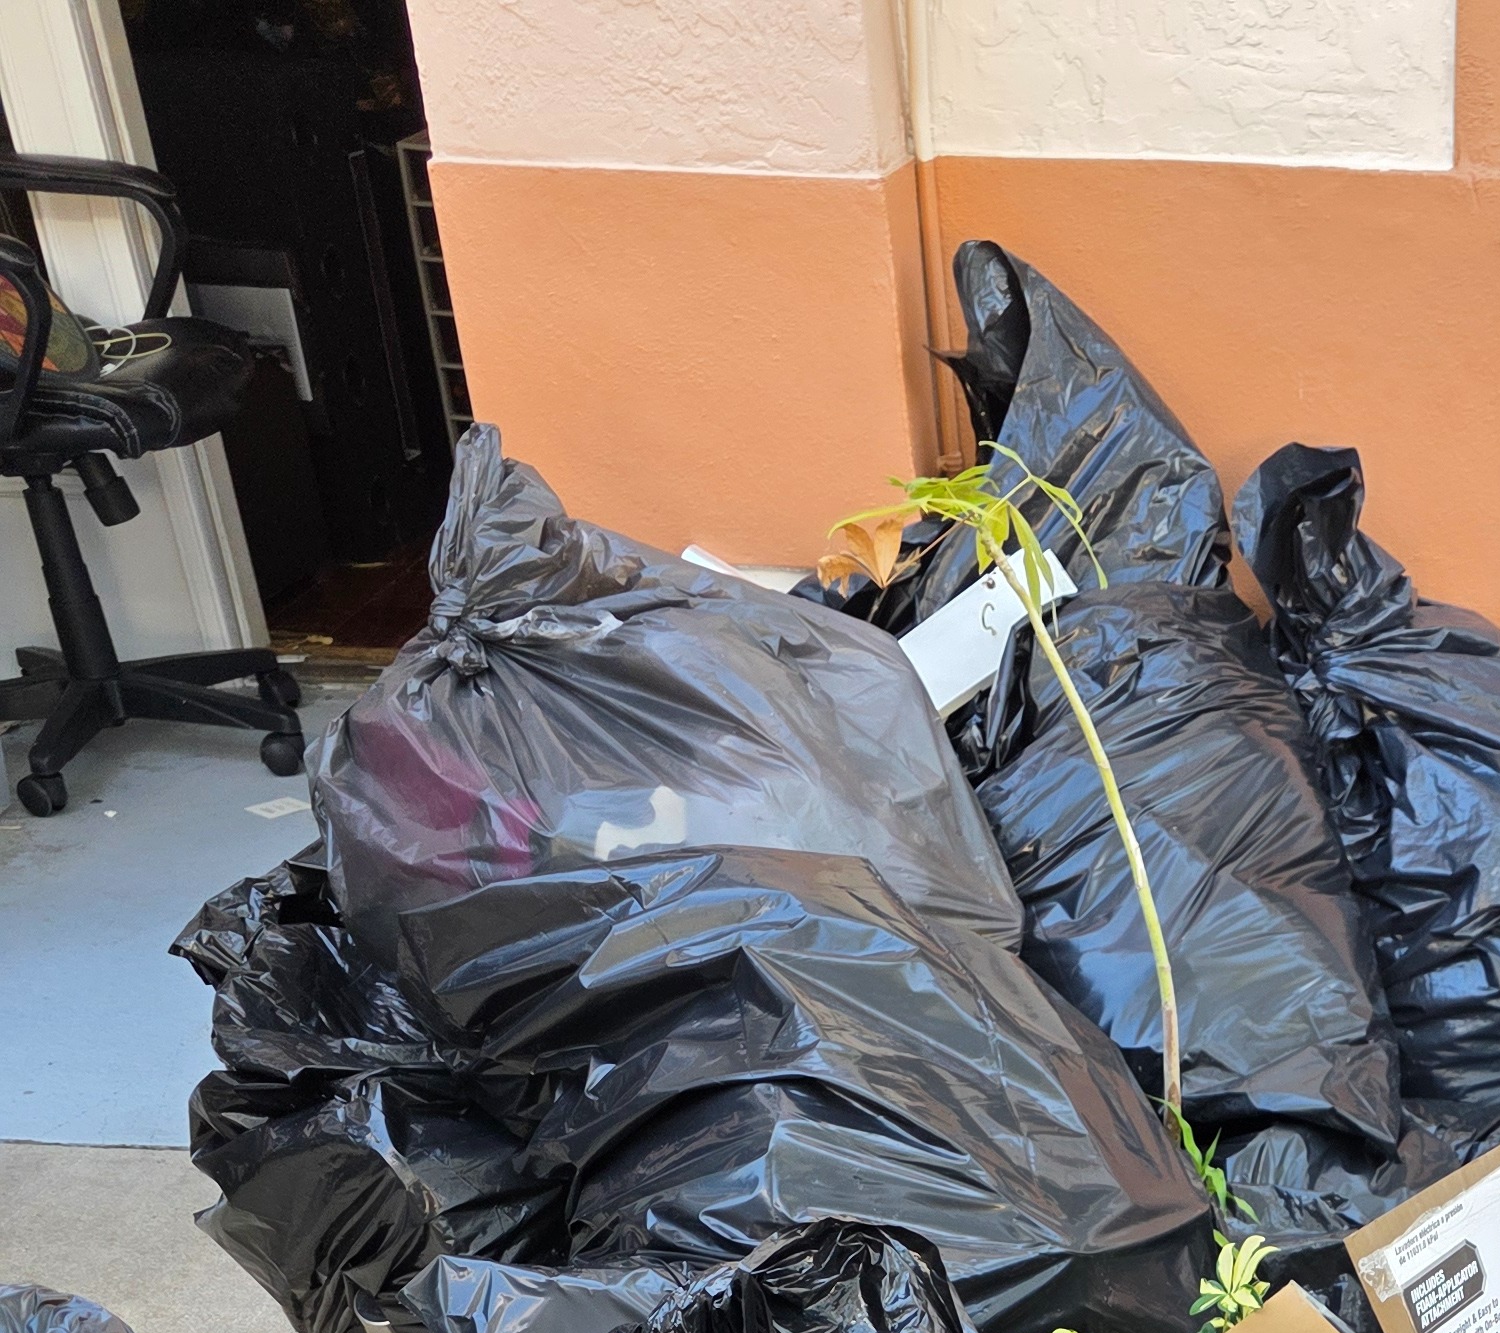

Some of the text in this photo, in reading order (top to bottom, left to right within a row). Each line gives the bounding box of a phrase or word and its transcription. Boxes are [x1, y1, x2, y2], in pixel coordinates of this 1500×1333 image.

[1411, 1269, 1446, 1304] INCLUDES
[1415, 1261, 1479, 1317] FOAM-APPLICATOR
[1420, 1286, 1465, 1329] ATTACHMENT
[1478, 1306, 1491, 1319] Easy
[1492, 1298, 1498, 1308] to
